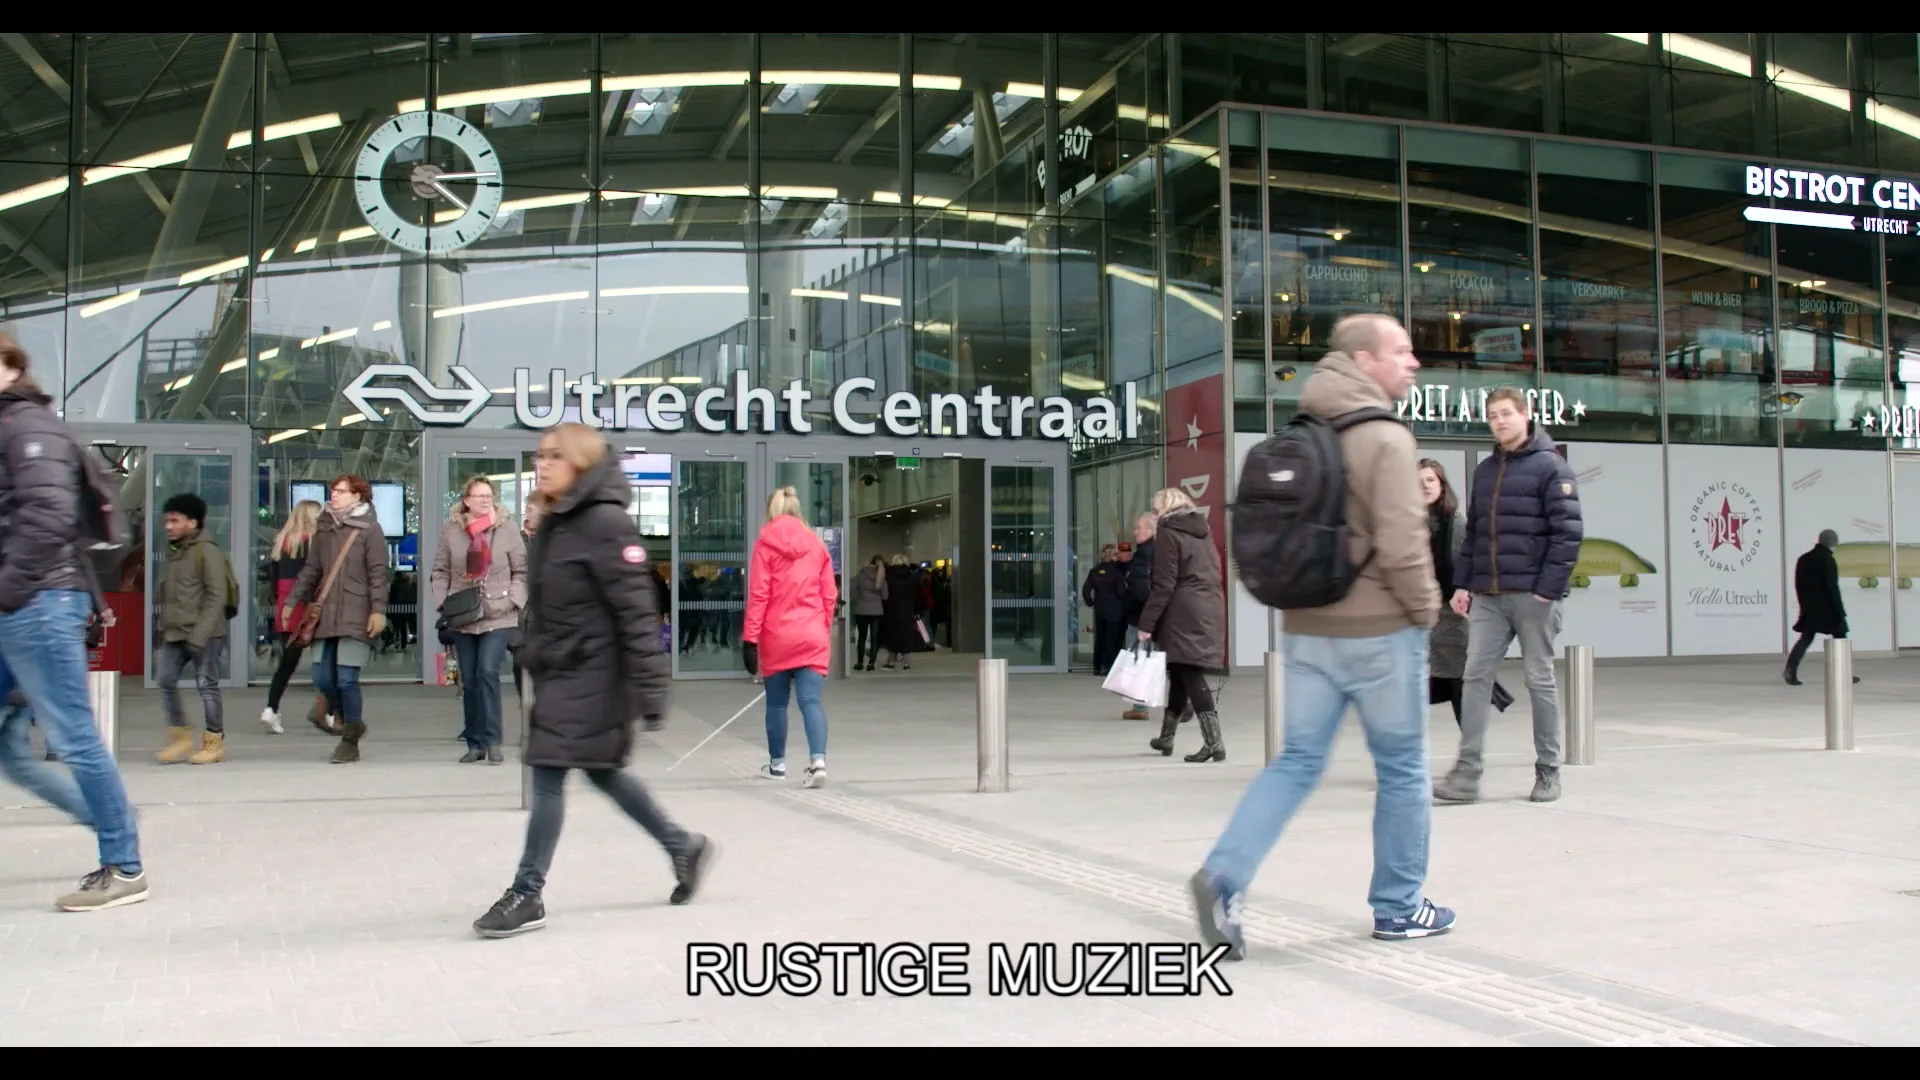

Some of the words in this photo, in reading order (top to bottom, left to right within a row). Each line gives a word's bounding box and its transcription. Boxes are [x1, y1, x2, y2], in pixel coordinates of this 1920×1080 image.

[1746, 165, 1865, 206] BISTROT
[1872, 179, 1920, 211] CEN
[1863, 216, 1909, 235] UTRECHT
[1305, 264, 1368, 282] CAPPUCCINO
[1450, 275, 1495, 291] FOCACCIA
[1571, 282, 1625, 300] VERSMARKT
[1722, 293, 1742, 307] BIER
[1799, 299, 1828, 313] BROOD
[1836, 302, 1860, 316] PIZZA
[514, 367, 812, 433] Utrecht
[832, 376, 1138, 439] Centraal
[1459, 388, 1472, 422] A
[1479, 387, 1567, 425] GER
[1690, 481, 1727, 522] ORGANIC
[1731, 483, 1762, 523] COFFEE
[1707, 511, 1746, 544] PRET
[1693, 539, 1737, 572] NATURAL
[1739, 539, 1761, 568] FOOD
[1686, 586, 1724, 606] Hello
[1725, 589, 1769, 606] Utrecht
